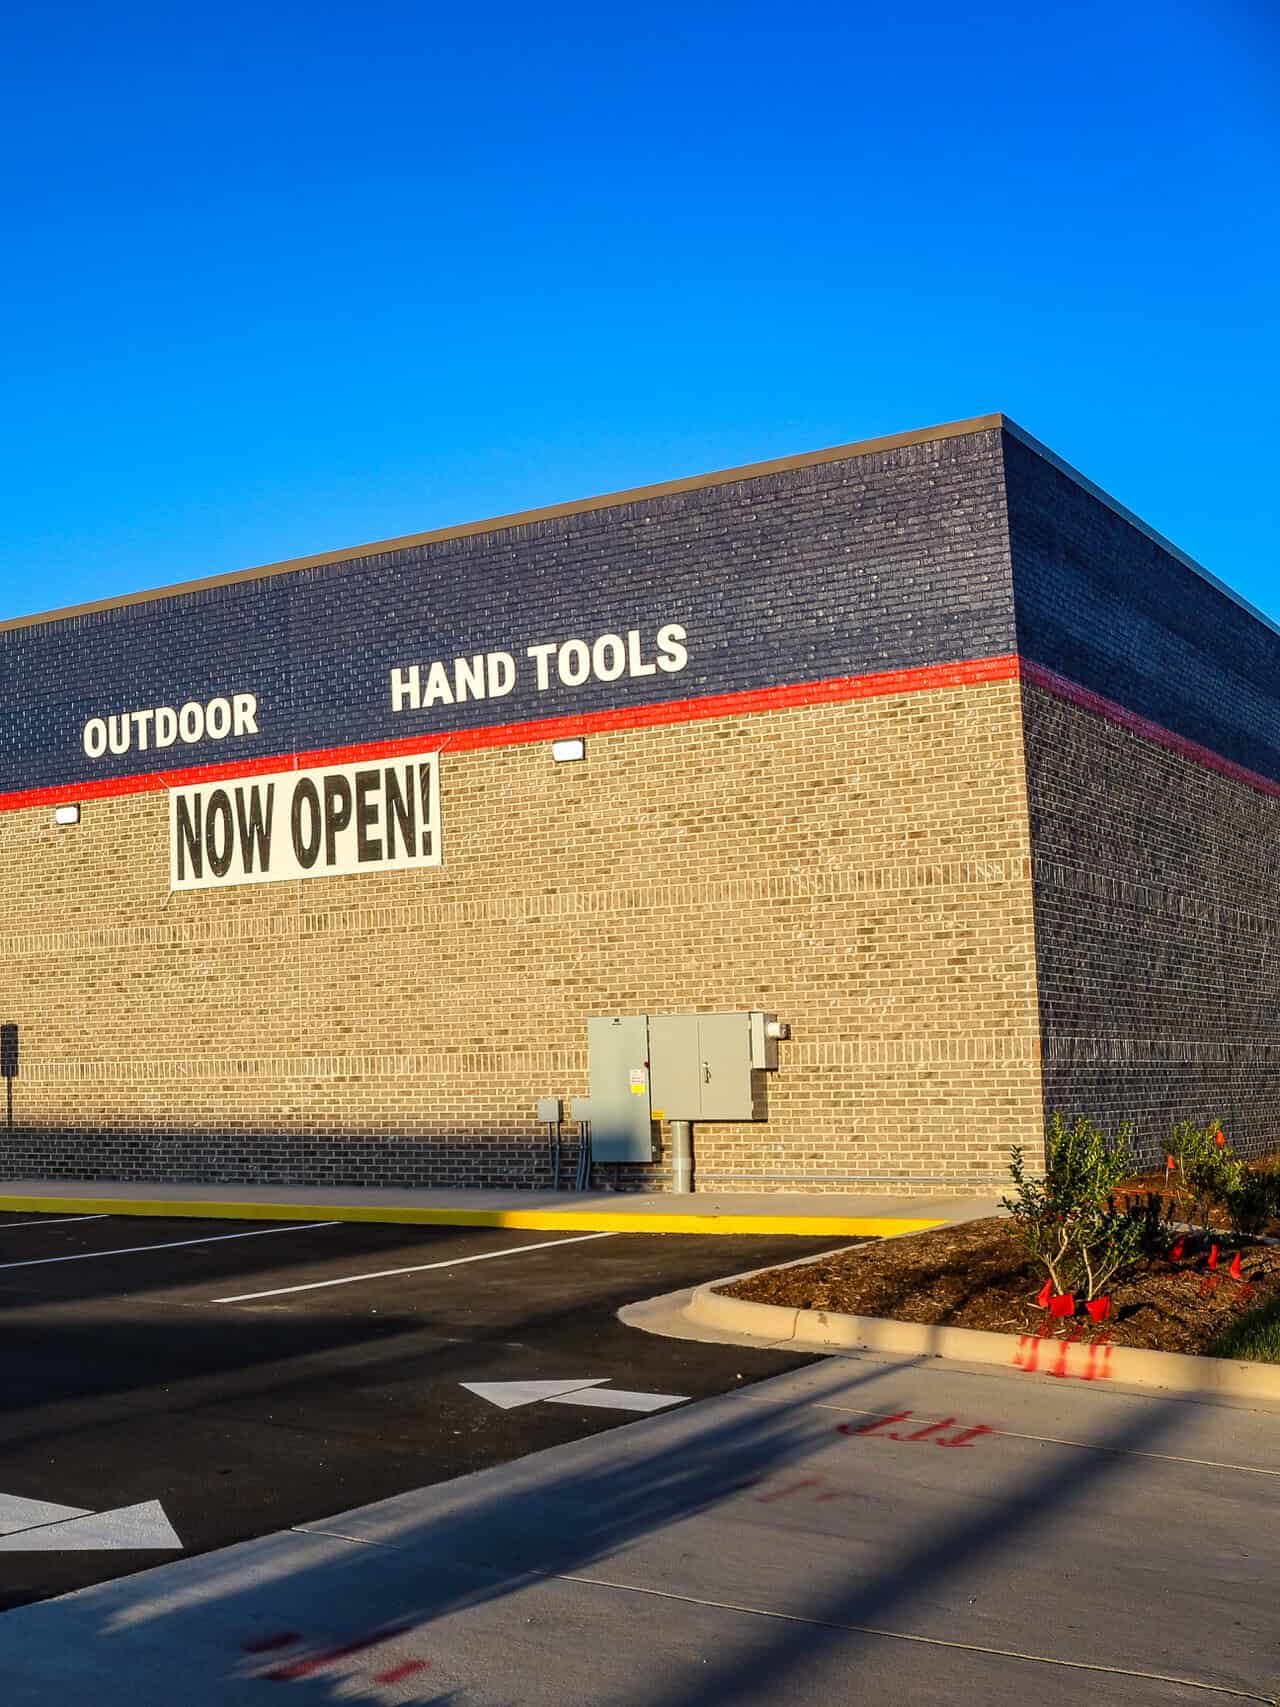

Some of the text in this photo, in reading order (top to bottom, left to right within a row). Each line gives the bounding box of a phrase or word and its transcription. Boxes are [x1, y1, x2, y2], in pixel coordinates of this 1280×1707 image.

[390, 623, 688, 712] HAND TOOLS
[83, 693, 259, 759] OUTDOOR
[177, 764, 433, 882] NOW OPEN!
